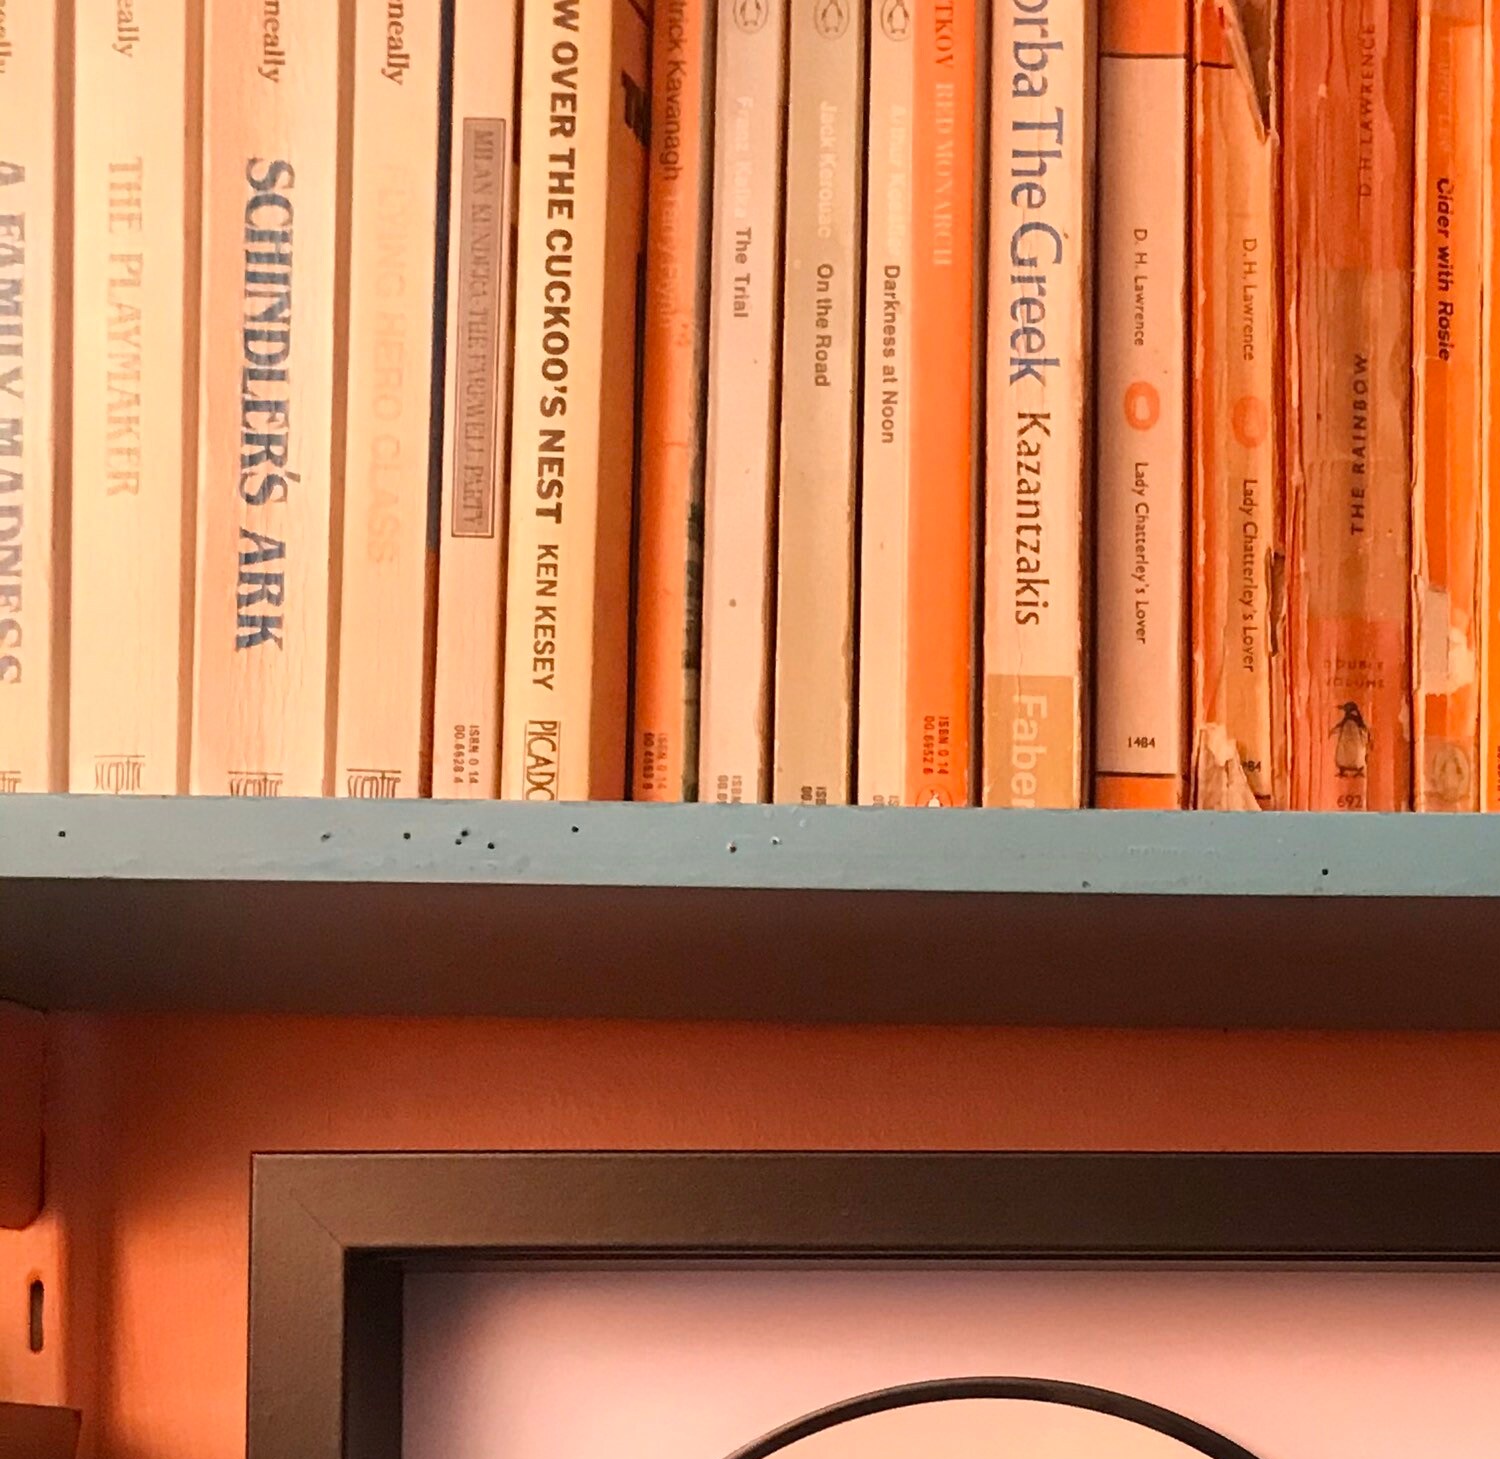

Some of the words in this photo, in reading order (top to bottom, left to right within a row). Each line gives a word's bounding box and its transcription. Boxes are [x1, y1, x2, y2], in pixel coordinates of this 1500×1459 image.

[549, 41, 579, 138] OVER
[660, 60, 687, 181] Kavanagh
[1358, 23, 1376, 145] LAWRENCE
[546, 148, 576, 220] THE
[1009, 106, 1065, 209] The
[107, 156, 143, 233] THE
[817, 153, 837, 239] Kerouac
[932, 139, 953, 266] MONARCH
[1436, 177, 1454, 238] Cider
[734, 226, 752, 264] The
[816, 263, 835, 292] On
[1436, 246, 1454, 292] with
[239, 157, 300, 507] SCHINDLER'S
[539, 228, 574, 418] CUCKOO'S
[733, 273, 751, 318] Trial
[815, 297, 834, 329] the
[882, 264, 902, 359] Darkness
[1008, 221, 1064, 387] Greek
[1133, 275, 1148, 346] Lawrence
[1240, 288, 1258, 361] Lawrence
[1436, 300, 1455, 361] Rosie
[105, 252, 143, 498] PLAYMAKER
[812, 335, 832, 387] Road
[882, 365, 897, 383] at
[880, 390, 899, 444] Noon
[1350, 353, 1369, 476] RAINBOW
[535, 428, 566, 525] NEST
[1130, 461, 1150, 496] Lady
[1237, 479, 1258, 517] Lady
[1349, 487, 1366, 536] THE
[1013, 411, 1051, 626] Kazantzakis
[1131, 502, 1151, 595] Chatterley's
[235, 526, 285, 652] ARK
[534, 544, 559, 595] KEN
[1237, 522, 1260, 622] Chatterley's
[531, 605, 557, 691] KESEY
[1133, 600, 1150, 644] Lover
[1240, 626, 1258, 673] Lover
[1336, 794, 1363, 809] 692
